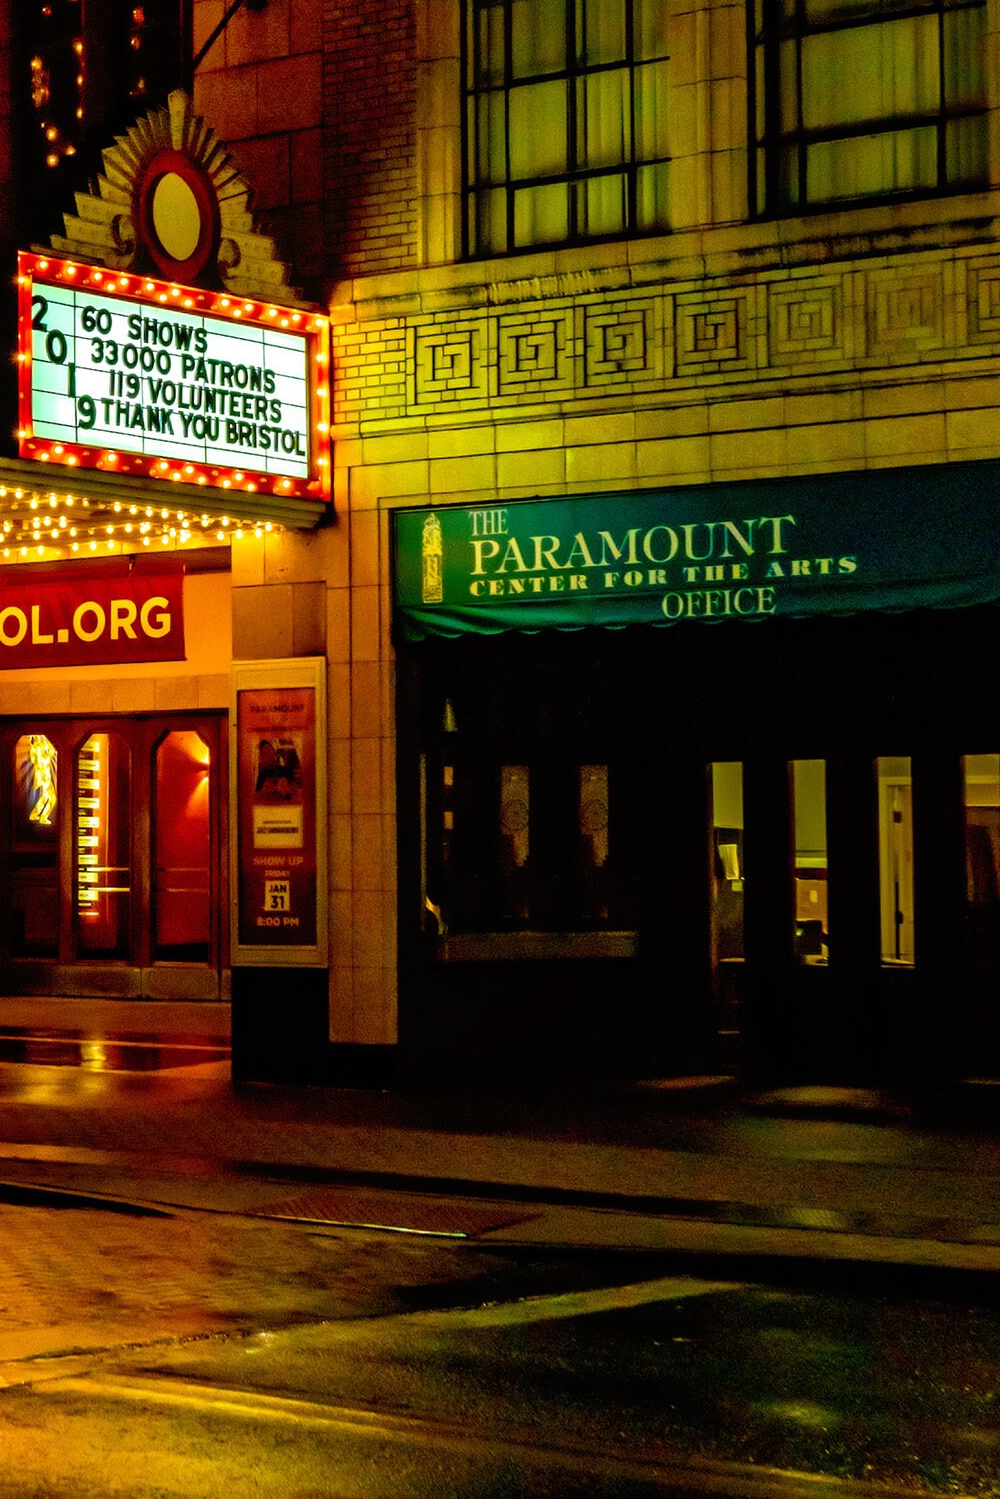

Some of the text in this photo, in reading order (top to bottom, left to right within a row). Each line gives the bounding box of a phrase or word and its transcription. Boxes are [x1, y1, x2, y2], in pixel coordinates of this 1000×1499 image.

[81, 305, 209, 354] 60 SHOWS
[181, 356, 276, 394] PATRONS
[110, 369, 282, 424] 119 VOLUNTEERS
[101, 398, 307, 457] THANK YOU BRISTOL
[468, 509, 509, 536] THE
[469, 514, 797, 575] PARAMOUNT
[469, 555, 858, 597] CENTER FOR THE ARTS
[662, 586, 777, 619] OFFICE
[253, 855, 305, 867] SHOW UP
[264, 869, 290, 878] FRIDAY
[269, 884, 287, 893] JAN
[270, 895, 285, 909] 31
[256, 916, 300, 927] 8:00 PM
